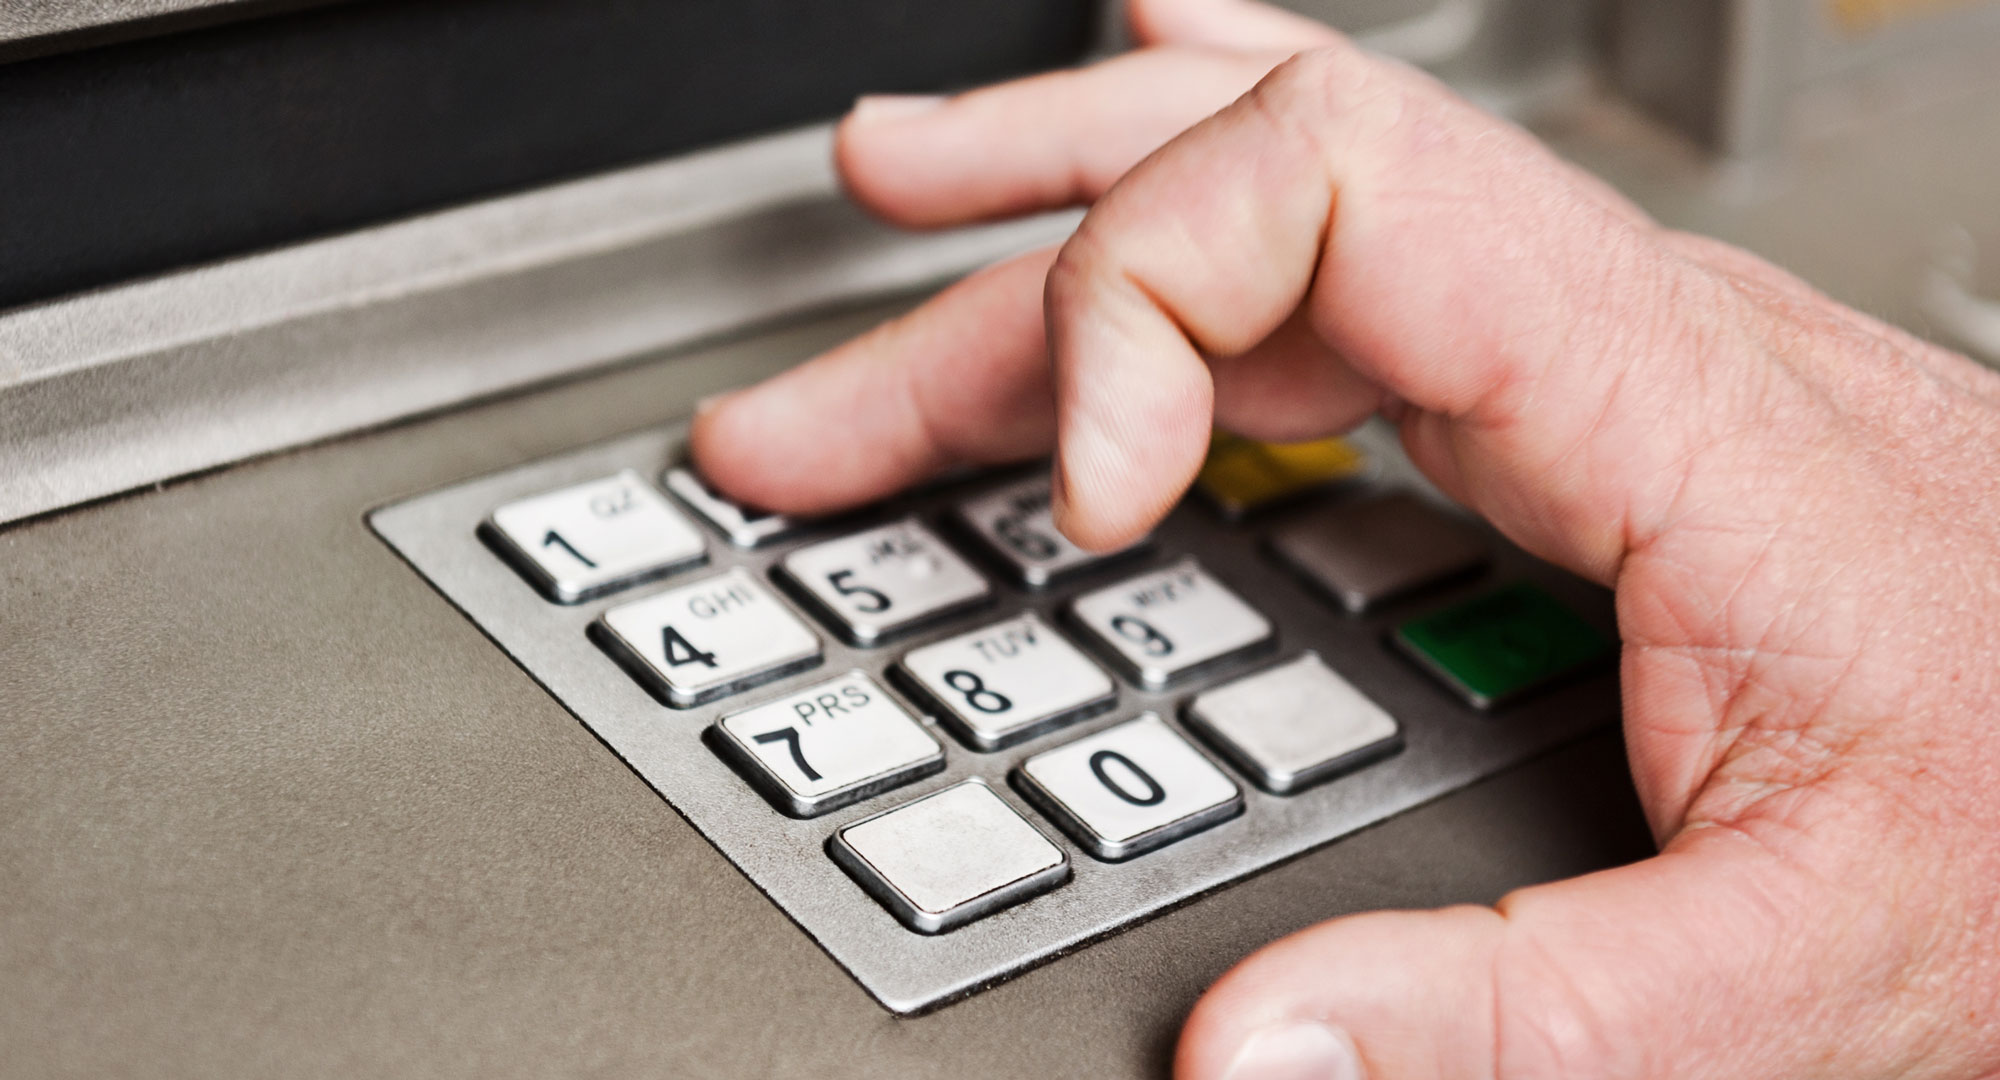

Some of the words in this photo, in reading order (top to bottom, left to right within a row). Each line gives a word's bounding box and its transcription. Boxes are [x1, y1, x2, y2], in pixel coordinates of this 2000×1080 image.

[543, 530, 597, 568] 1
[826, 568, 893, 614] 5
[661, 624, 718, 668] 4
[1110, 615, 1175, 658] 9
[793, 684, 870, 727] PRS
[943, 669, 1013, 715] 8
[753, 726, 823, 783] 7
[1089, 749, 1166, 807] 0
